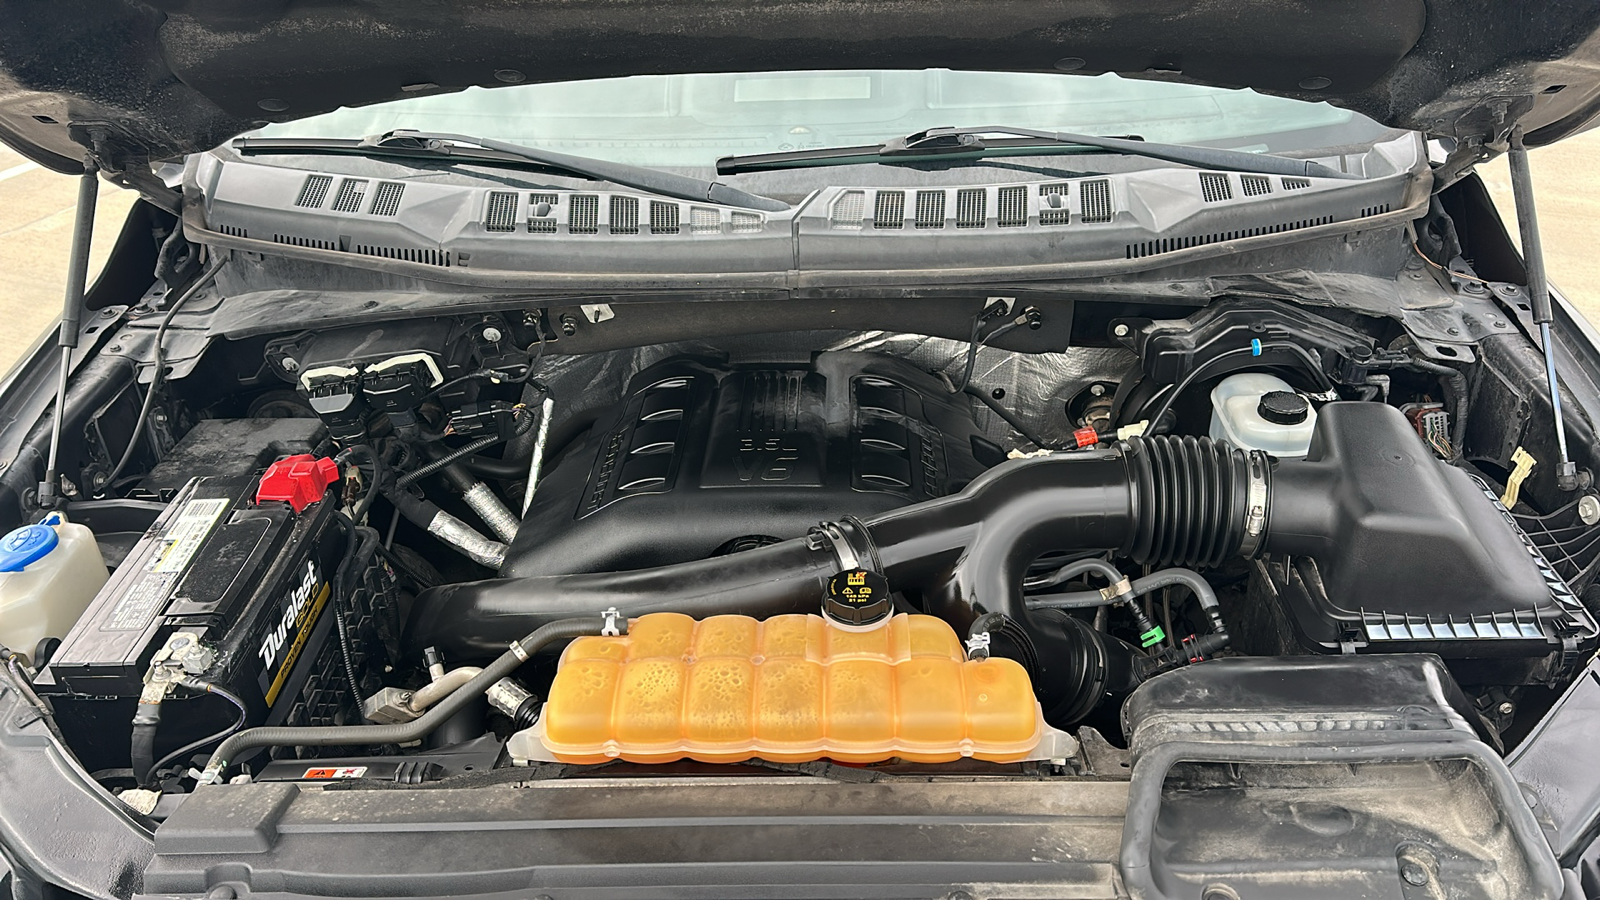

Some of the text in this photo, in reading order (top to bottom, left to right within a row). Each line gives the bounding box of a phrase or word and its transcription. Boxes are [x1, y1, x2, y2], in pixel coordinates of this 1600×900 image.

[740, 438, 797, 452] 3.5L
[732, 456, 798, 481] V6
[258, 560, 317, 670] Duralast
[296, 583, 319, 627] GOLD
[280, 606, 319, 679] PROVEN TOUGH
